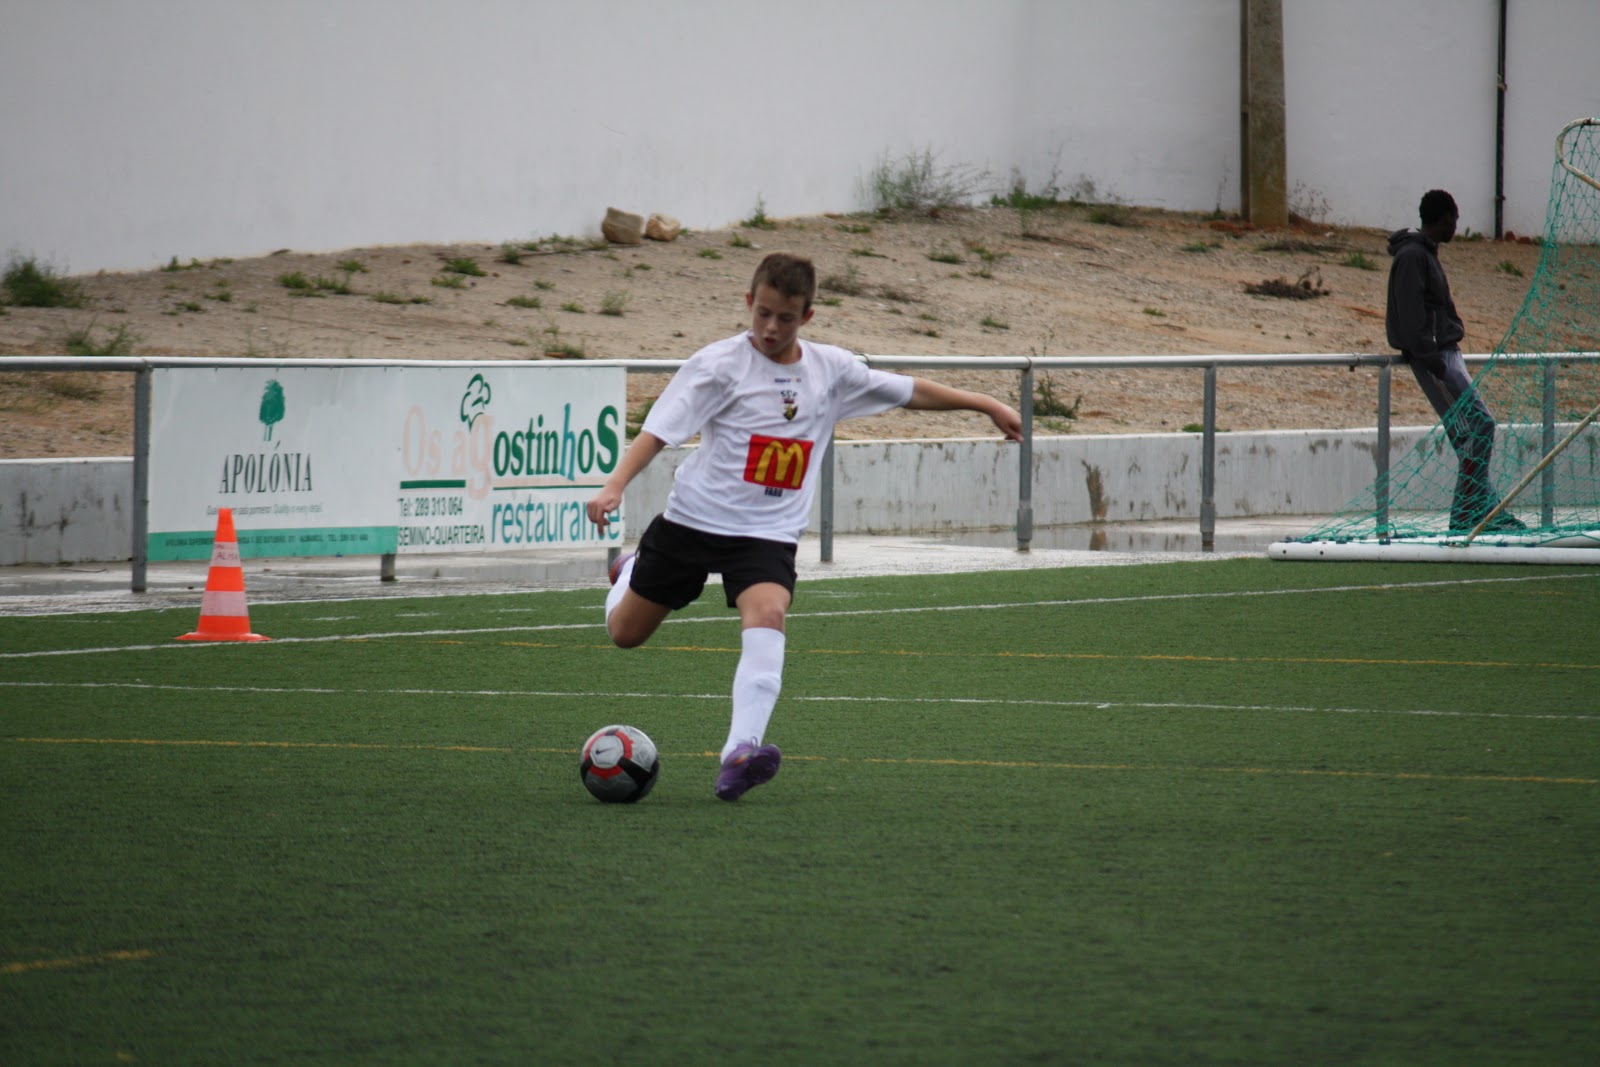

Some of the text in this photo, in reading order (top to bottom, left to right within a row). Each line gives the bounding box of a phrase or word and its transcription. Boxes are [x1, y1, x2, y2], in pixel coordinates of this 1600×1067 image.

[218, 440, 313, 494] APOLÓNIA
[402, 404, 443, 478] Os
[415, 497, 430, 517] 289
[431, 497, 447, 516] 313
[448, 496, 463, 516] 064
[491, 494, 620, 544] restaurane
